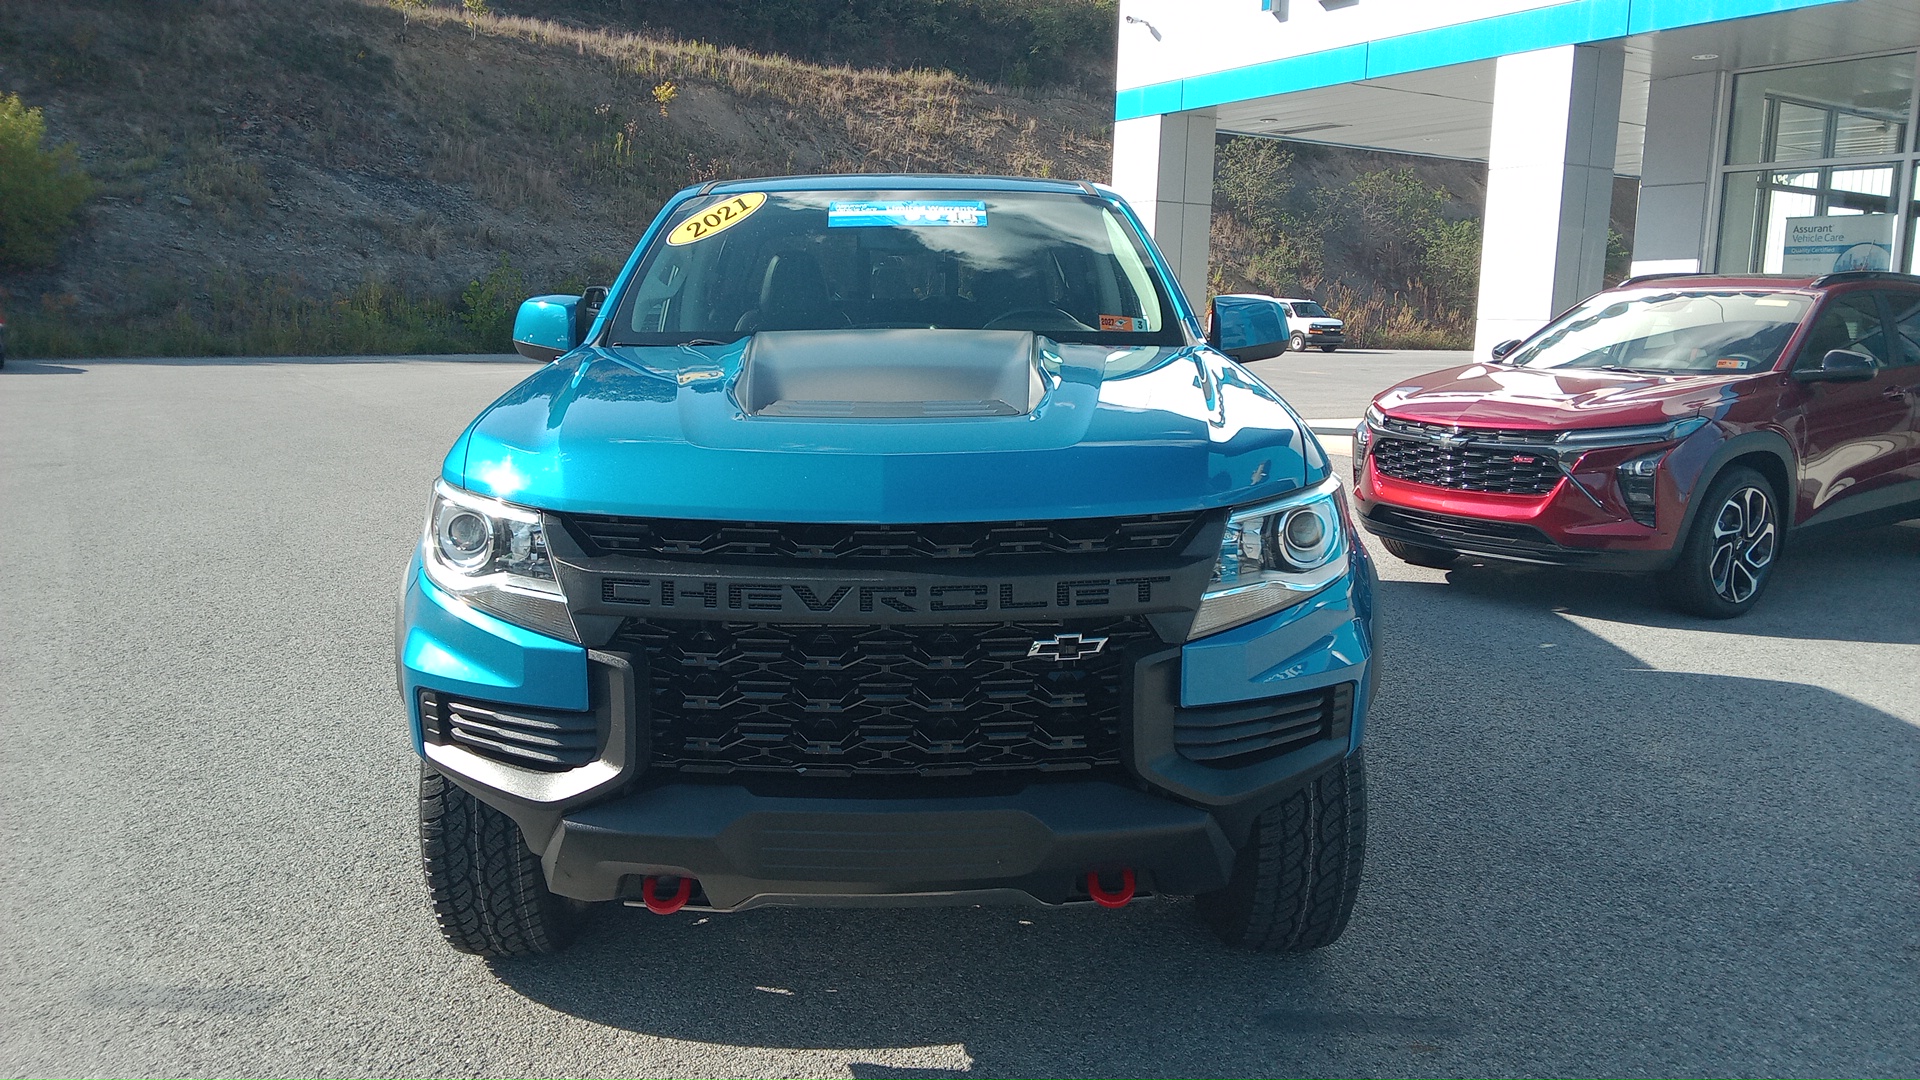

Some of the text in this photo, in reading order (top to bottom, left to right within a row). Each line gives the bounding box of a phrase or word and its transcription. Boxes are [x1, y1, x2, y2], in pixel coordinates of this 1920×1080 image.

[686, 198, 752, 238] 2021
[1792, 224, 1833, 233] Assurant
[1792, 233, 1845, 243] Vehicle Care
[602, 576, 1171, 612] CHEVROLET
